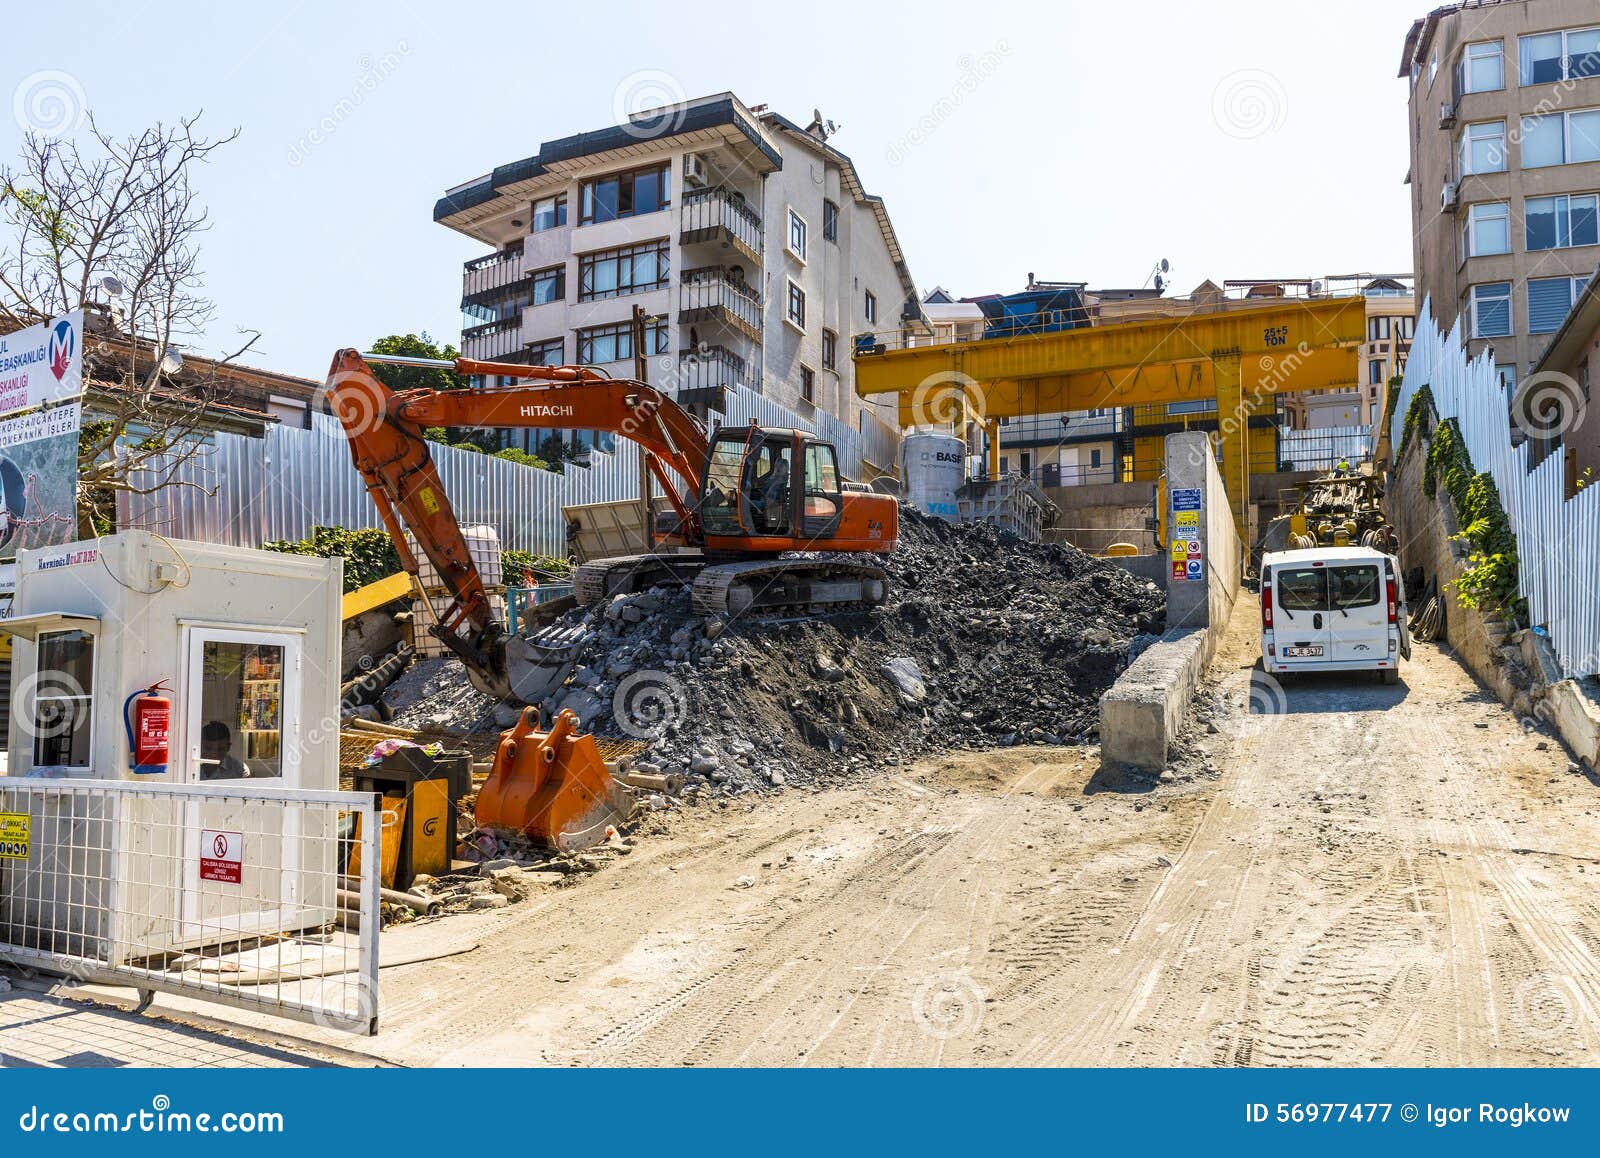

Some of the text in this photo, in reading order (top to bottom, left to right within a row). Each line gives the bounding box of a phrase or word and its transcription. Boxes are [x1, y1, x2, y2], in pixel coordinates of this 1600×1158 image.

[1264, 325, 1288, 337] 25+5
[1264, 336, 1286, 347] TON
[4, 345, 46, 371] BAŞKANLIĞI
[520, 405, 573, 417] HITACHI
